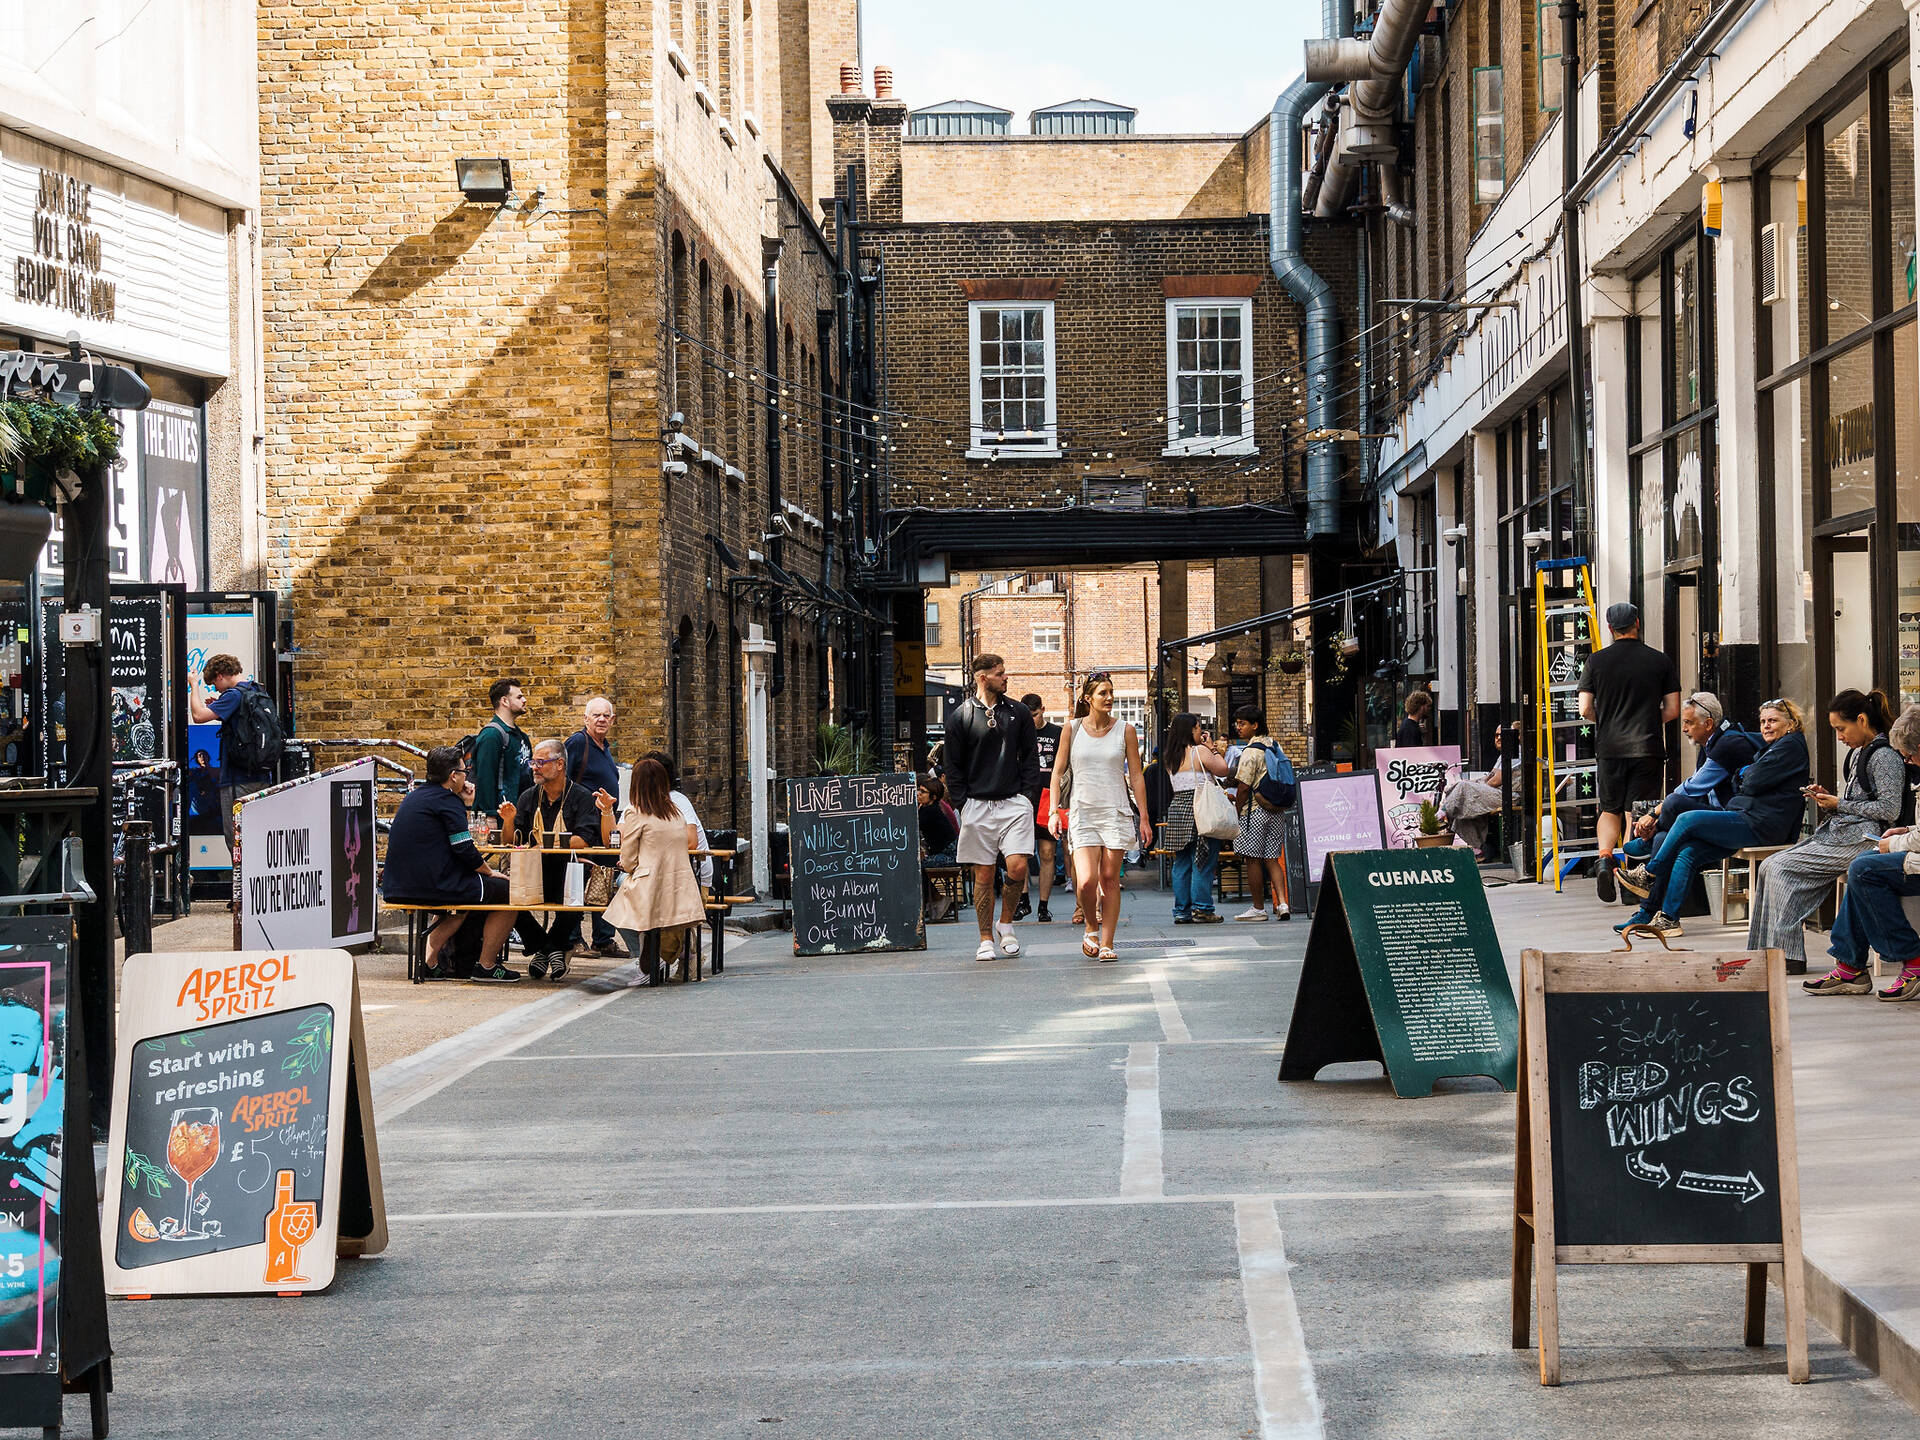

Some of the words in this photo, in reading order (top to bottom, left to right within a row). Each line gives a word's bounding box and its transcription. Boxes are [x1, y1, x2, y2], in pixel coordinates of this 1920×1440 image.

[17, 256, 86, 314] ERUPTING
[144, 411, 165, 458] THE
[166, 416, 198, 464] HIVES
[111, 667, 147, 676] KNOW
[266, 830, 284, 869] OUT
[285, 828, 310, 867] NOW!!
[803, 822, 846, 851] Willie
[863, 817, 908, 851] Healey
[1313, 833, 1352, 843] LOADING
[1357, 831, 1373, 839] BAY
[804, 858, 839, 875] Doors
[844, 855, 854, 870] @
[1368, 868, 1455, 887] CUEMARS
[249, 873, 282, 916] YOU'RE
[282, 869, 326, 912] WELCOME.
[811, 882, 836, 901] New
[821, 899, 877, 926] Bunny
[808, 924, 839, 944] Out
[176, 955, 297, 1008] APEROL
[148, 1051, 203, 1078] Start
[208, 1039, 255, 1065] with
[260, 1040, 274, 1054] a
[155, 1068, 265, 1105] refreshing
[1579, 1061, 1669, 1110] RED
[230, 1086, 312, 1123] APEROL
[1606, 1075, 1760, 1147] WINGS
[6, 1281, 26, 1289] WINE
